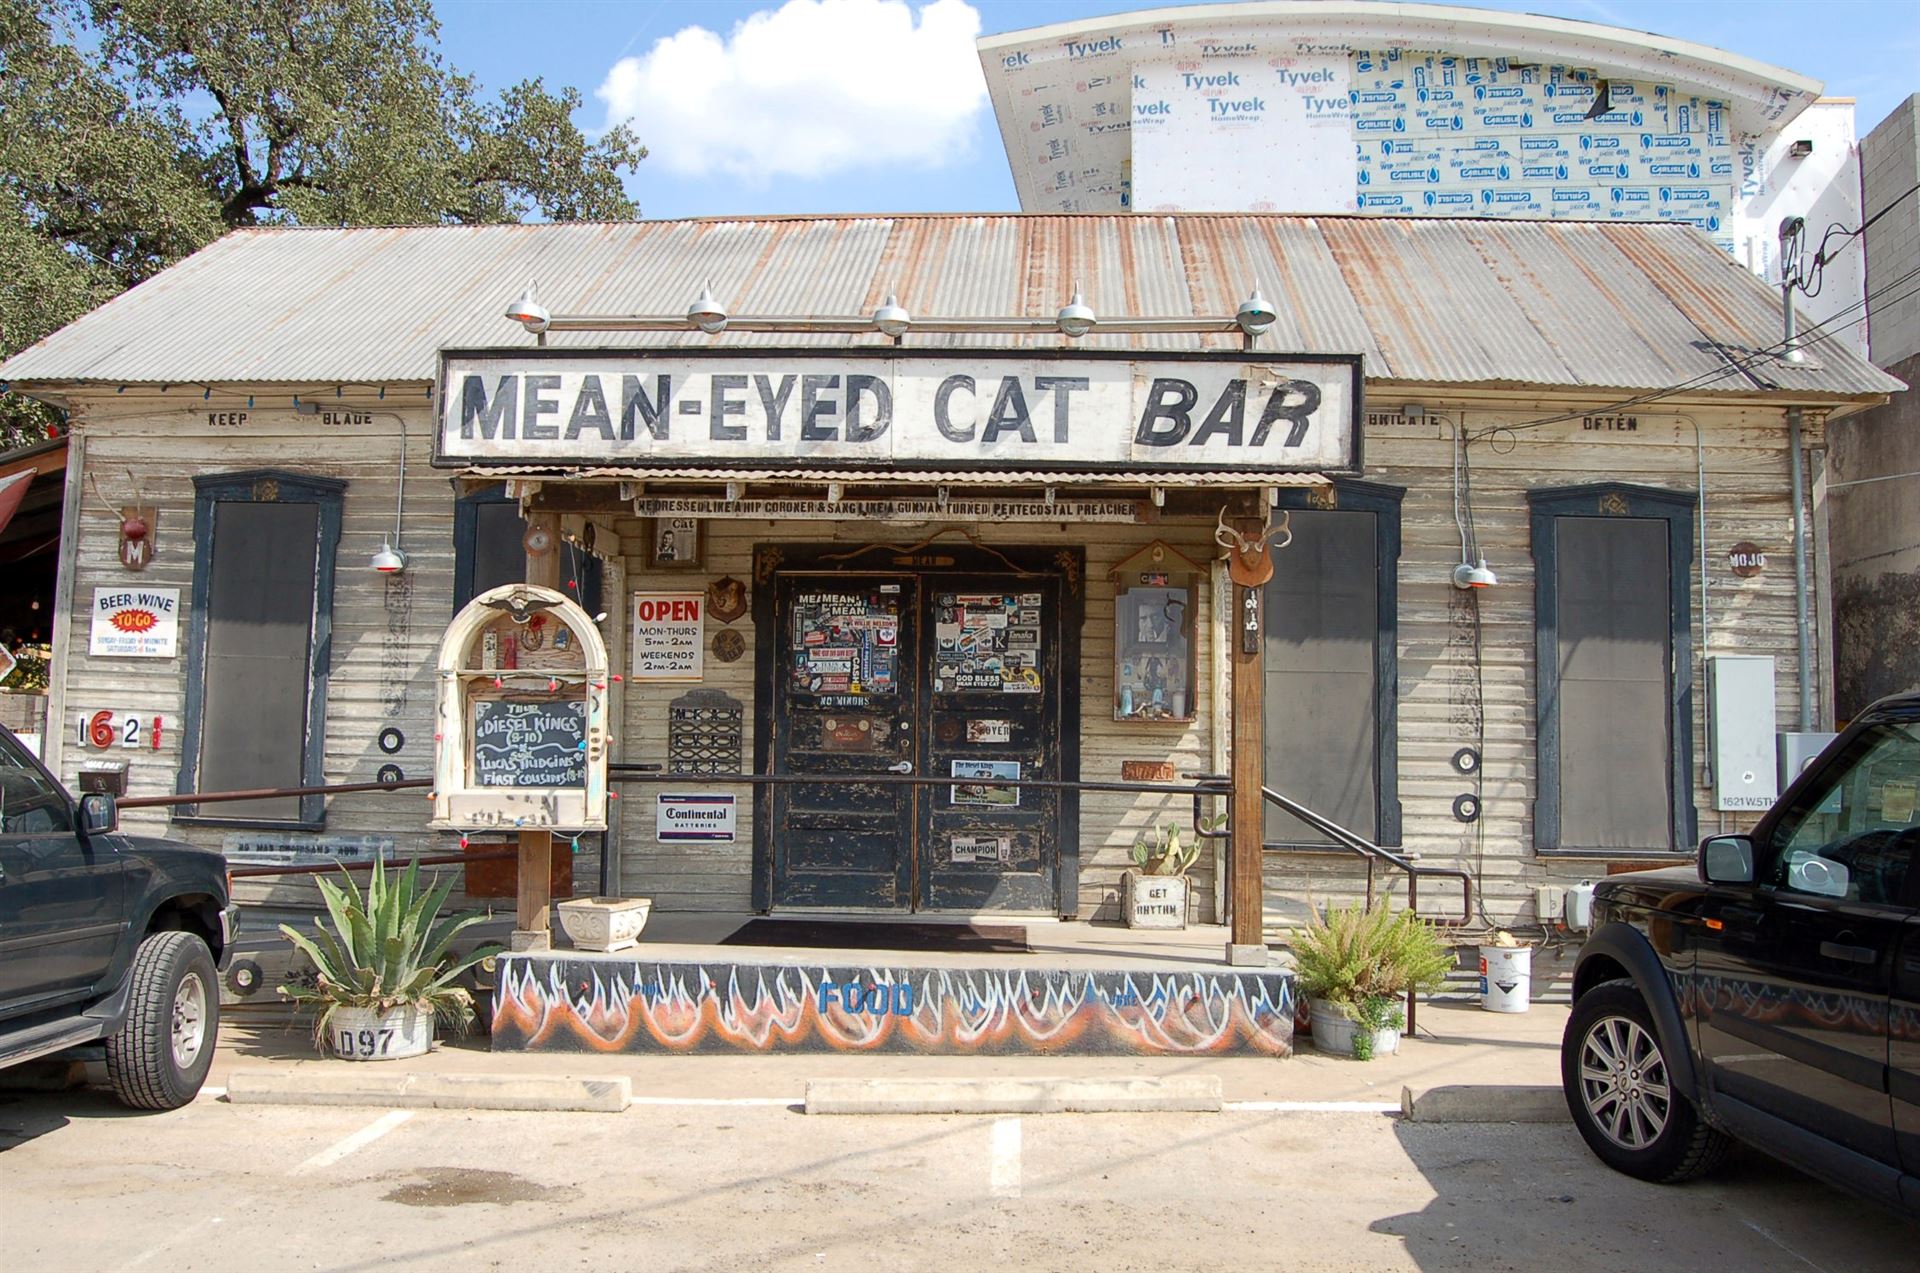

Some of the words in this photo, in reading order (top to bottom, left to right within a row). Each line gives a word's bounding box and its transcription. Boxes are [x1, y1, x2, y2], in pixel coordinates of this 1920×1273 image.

[1064, 36, 1122, 57] Tyvek
[1203, 44, 1257, 53] Tyvek
[1182, 71, 1240, 90] Tyvek
[1276, 68, 1335, 86] Tyvek
[1208, 97, 1265, 116] Tyvek
[1357, 120, 1392, 129] CARLISLE
[1484, 115, 1519, 125] CARLISLE
[1391, 171, 1425, 180] CARLISLE
[1461, 168, 1495, 177] CARLISLE
[1650, 164, 1685, 174] CARLISLE
[1738, 141, 1756, 201] Tyvek
[459, 374, 893, 443] MEAN-EYED
[934, 374, 1090, 445] CAT
[1134, 377, 1322, 448] BAR
[208, 413, 247, 426] KEEP
[1582, 416, 1637, 431] OFTEN
[638, 501, 652, 512] HE
[654, 501, 702, 512] DRESSED
[706, 501, 731, 513] LIKE
[733, 501, 741, 513] A
[743, 502, 761, 513] HIP
[764, 502, 814, 513] CORONER
[817, 502, 826, 513] &
[827, 502, 855, 514] SANG
[858, 502, 883, 514] LIKE
[886, 502, 894, 513] A
[898, 502, 942, 513] GUNMAN
[947, 502, 988, 515] TURNED
[993, 503, 1073, 516] PENTECOSTAL
[1077, 504, 1136, 516] PREACHER
[672, 518, 694, 529] Cat
[126, 541, 143, 564] M
[1730, 553, 1764, 567] MOJO
[100, 593, 132, 610] BEER
[138, 593, 174, 612] WINE
[639, 601, 699, 621] OPEN
[832, 607, 865, 615] MEAN
[639, 627, 697, 636] MON-THURS
[996, 637, 1005, 648] K
[640, 651, 694, 659] WEEKENDS
[852, 657, 860, 684] CASH
[820, 697, 832, 705] NO
[837, 697, 870, 705] MINORS
[78, 710, 163, 750] 1621
[1723, 797, 1745, 807] 1621
[666, 807, 727, 820] Continental
[955, 845, 996, 854] CHAMPION
[1150, 889, 1167, 898] GET
[1137, 905, 1177, 915] RHYTHM
[819, 982, 913, 1016] FOOD
[340, 1030, 394, 1056] D97
